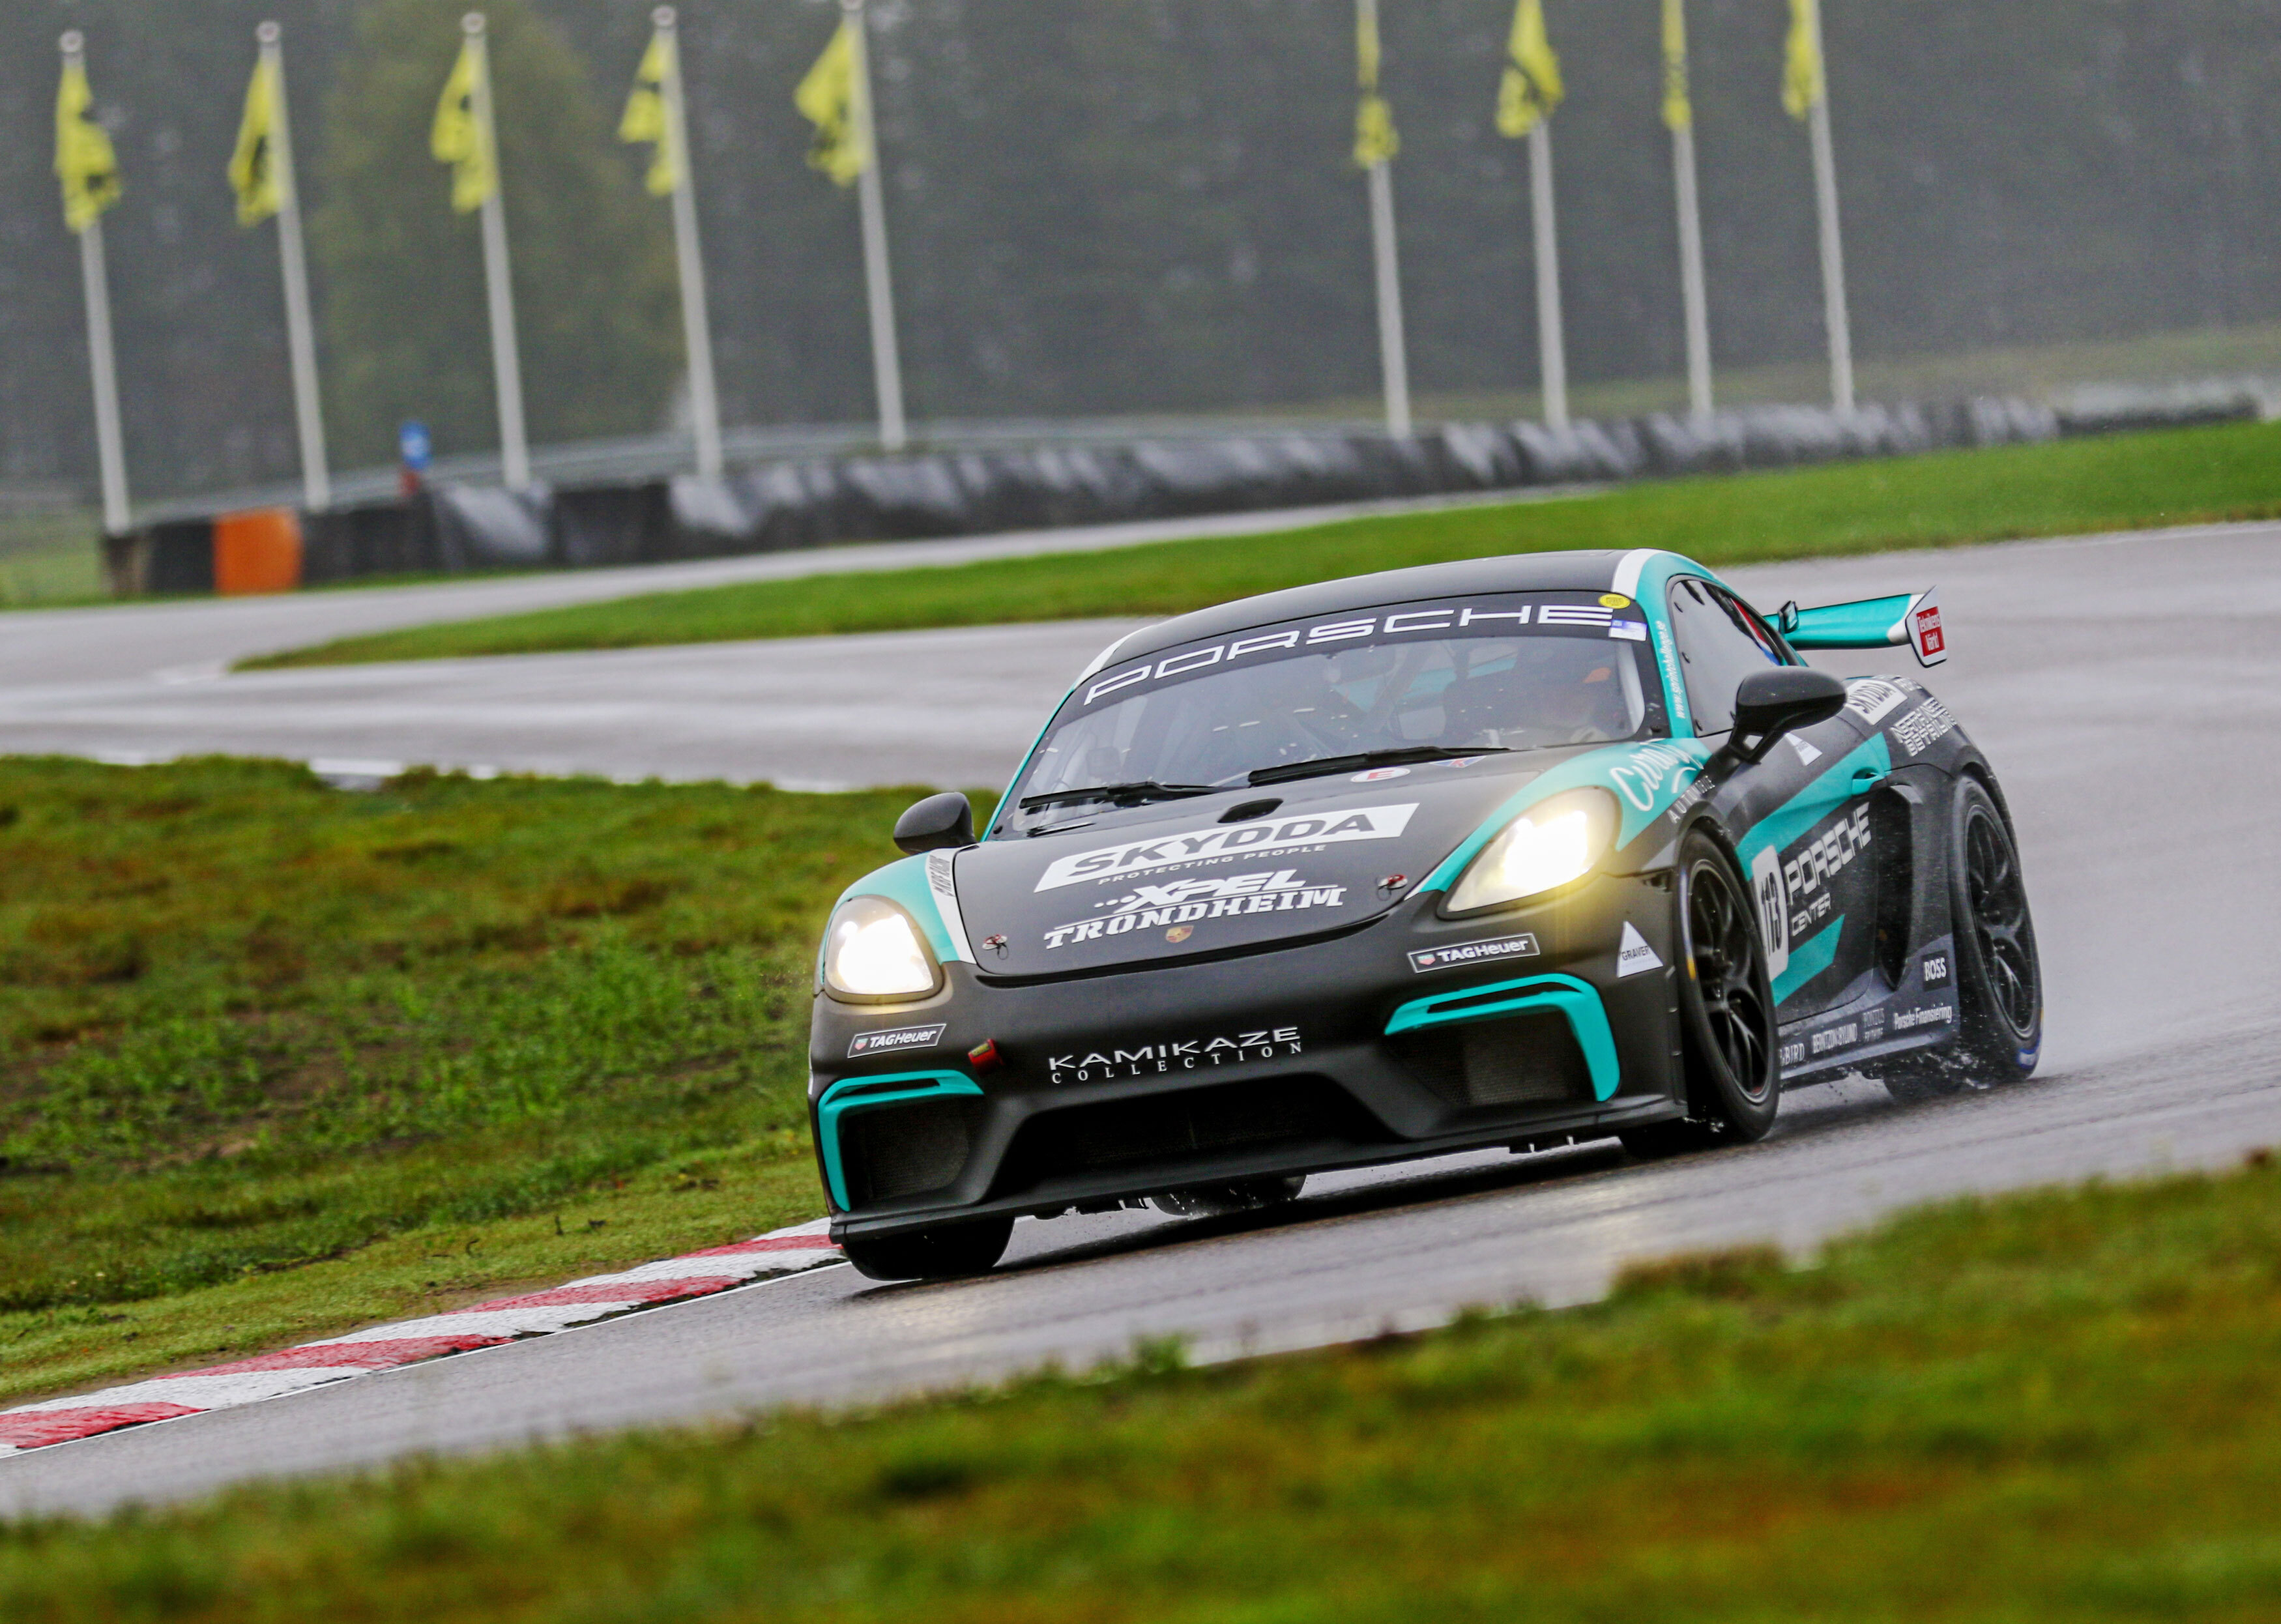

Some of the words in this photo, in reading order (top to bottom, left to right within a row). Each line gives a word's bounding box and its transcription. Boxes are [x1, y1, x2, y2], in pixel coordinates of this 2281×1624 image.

[1084, 605, 1614, 706] PORSCHE
[1065, 814, 1377, 878] SKYDDA
[1097, 855, 1235, 885] PROTECTING
[1243, 844, 1326, 861] PEOPLE
[1784, 802, 1872, 906] PORSCHE
[1113, 869, 1306, 913] XPEL
[1043, 887, 1347, 950] TRONDHEIM
[1791, 893, 1831, 936] CENTER
[1621, 946, 1651, 961] GRAVER
[1924, 957, 1947, 981] BOSS
[1049, 1026, 1301, 1071] KAMIKAZE
[1051, 1042, 1303, 1084] COLLECTION
